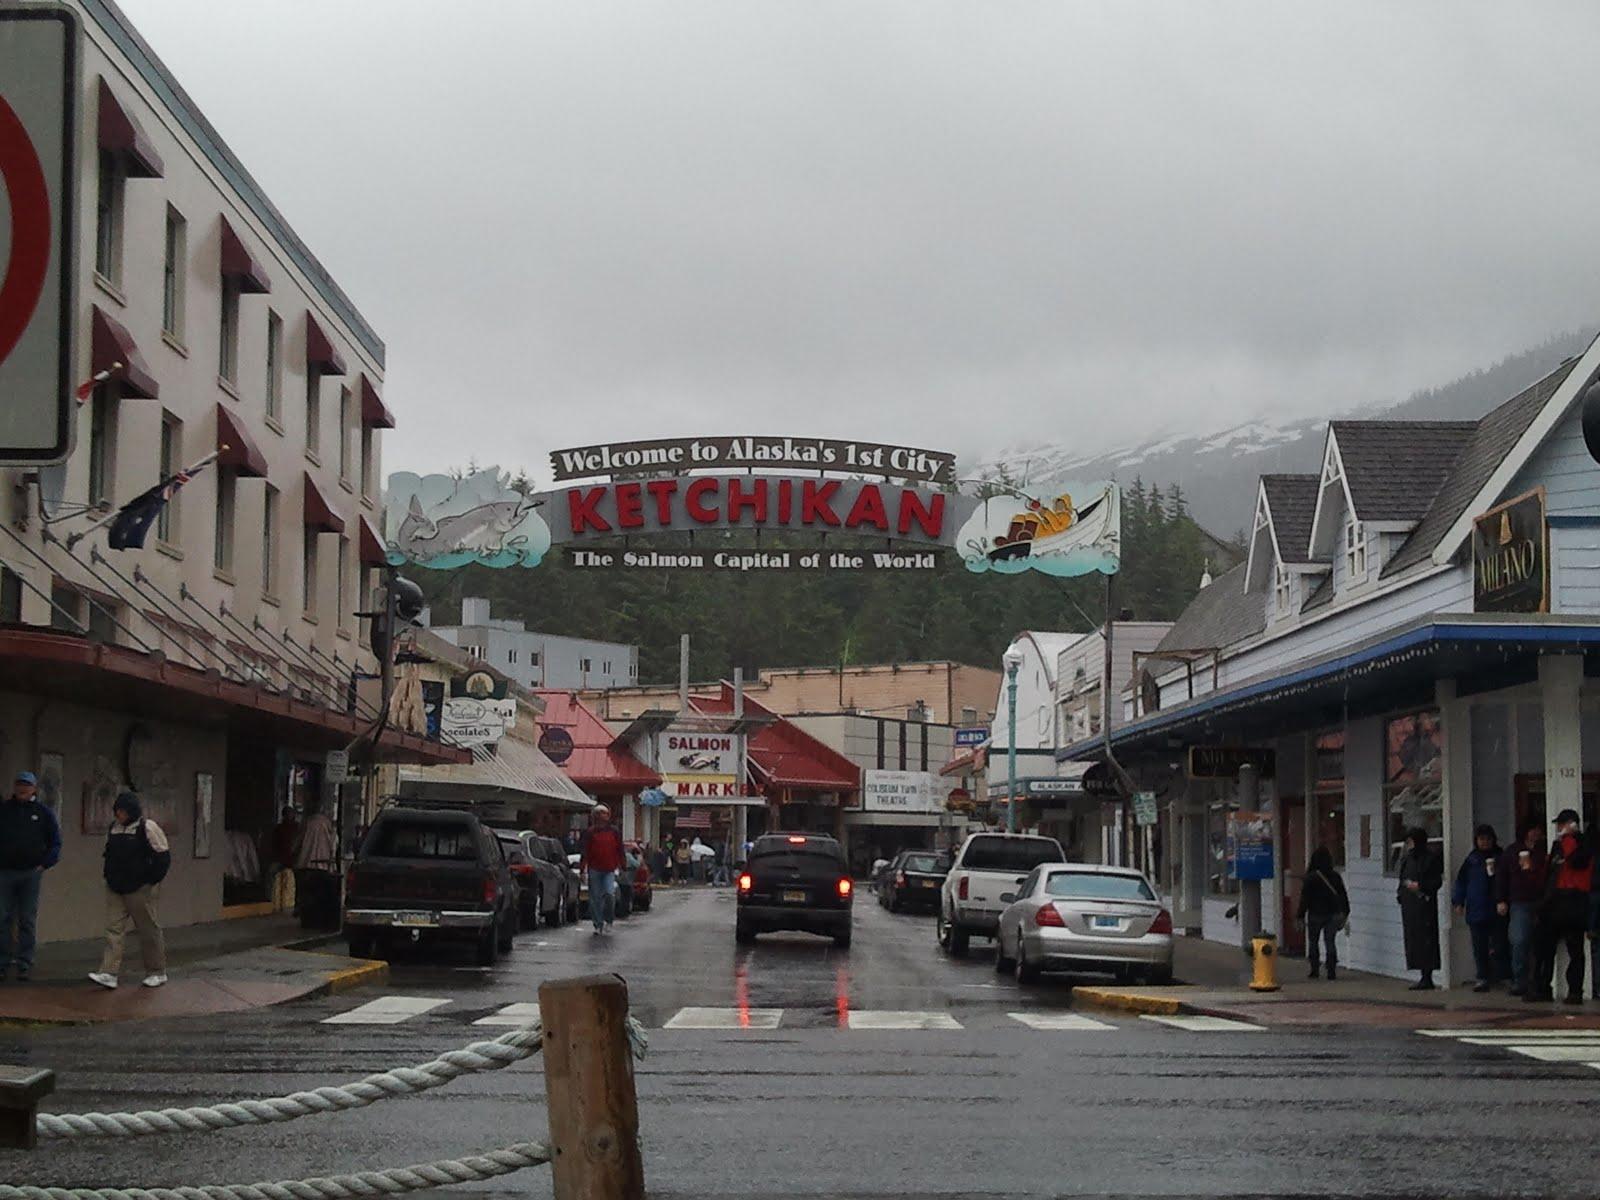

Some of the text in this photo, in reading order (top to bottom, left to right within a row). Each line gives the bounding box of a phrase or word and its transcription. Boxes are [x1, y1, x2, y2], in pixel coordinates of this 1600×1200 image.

[560, 438, 945, 481] Welcome to Alaska's 1st City
[567, 477, 945, 538] KETCHIKAN
[572, 551, 935, 570] The Salmon Capital of the World
[1481, 539, 1535, 593] MILANO
[668, 737, 731, 751] SALMON
[1037, 782, 1075, 791] ALASKAN
